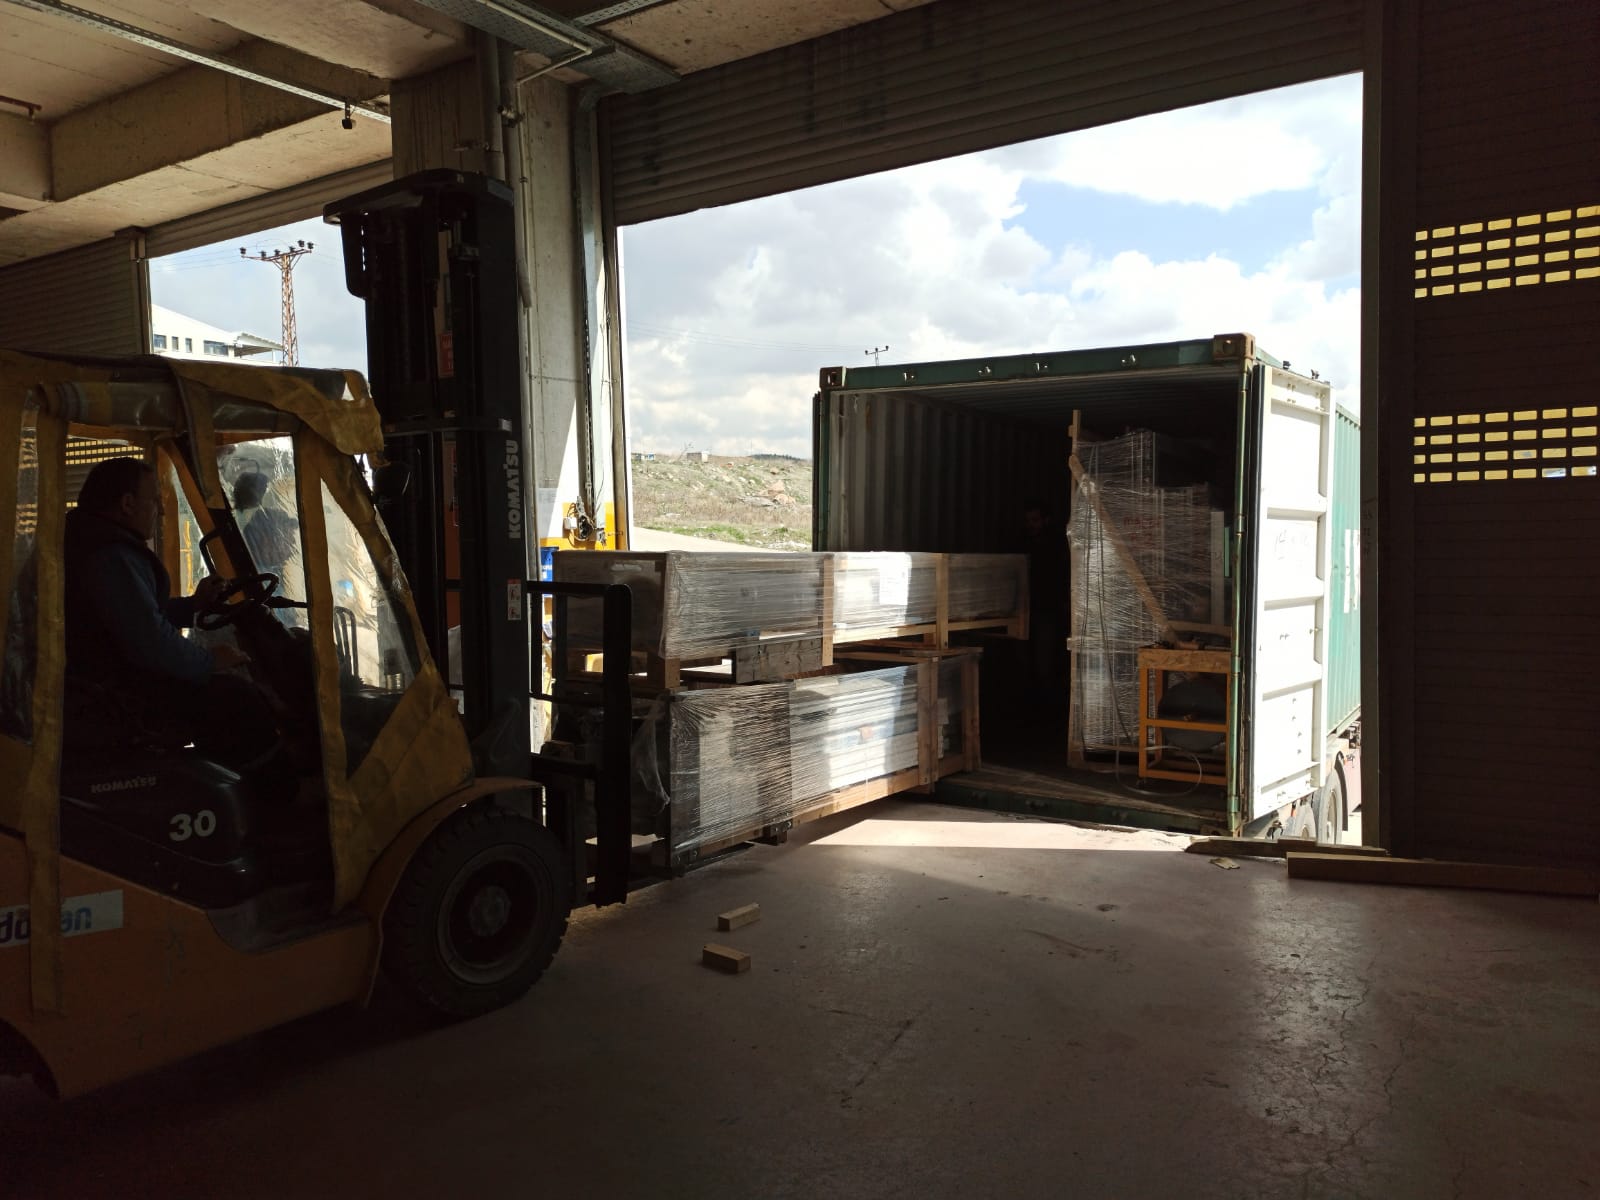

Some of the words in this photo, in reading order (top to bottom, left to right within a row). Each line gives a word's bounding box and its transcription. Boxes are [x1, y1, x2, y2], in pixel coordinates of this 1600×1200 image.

[503, 440, 521, 539] KOMATSU
[91, 776, 157, 793] KOMATSU
[168, 809, 217, 842] 30
